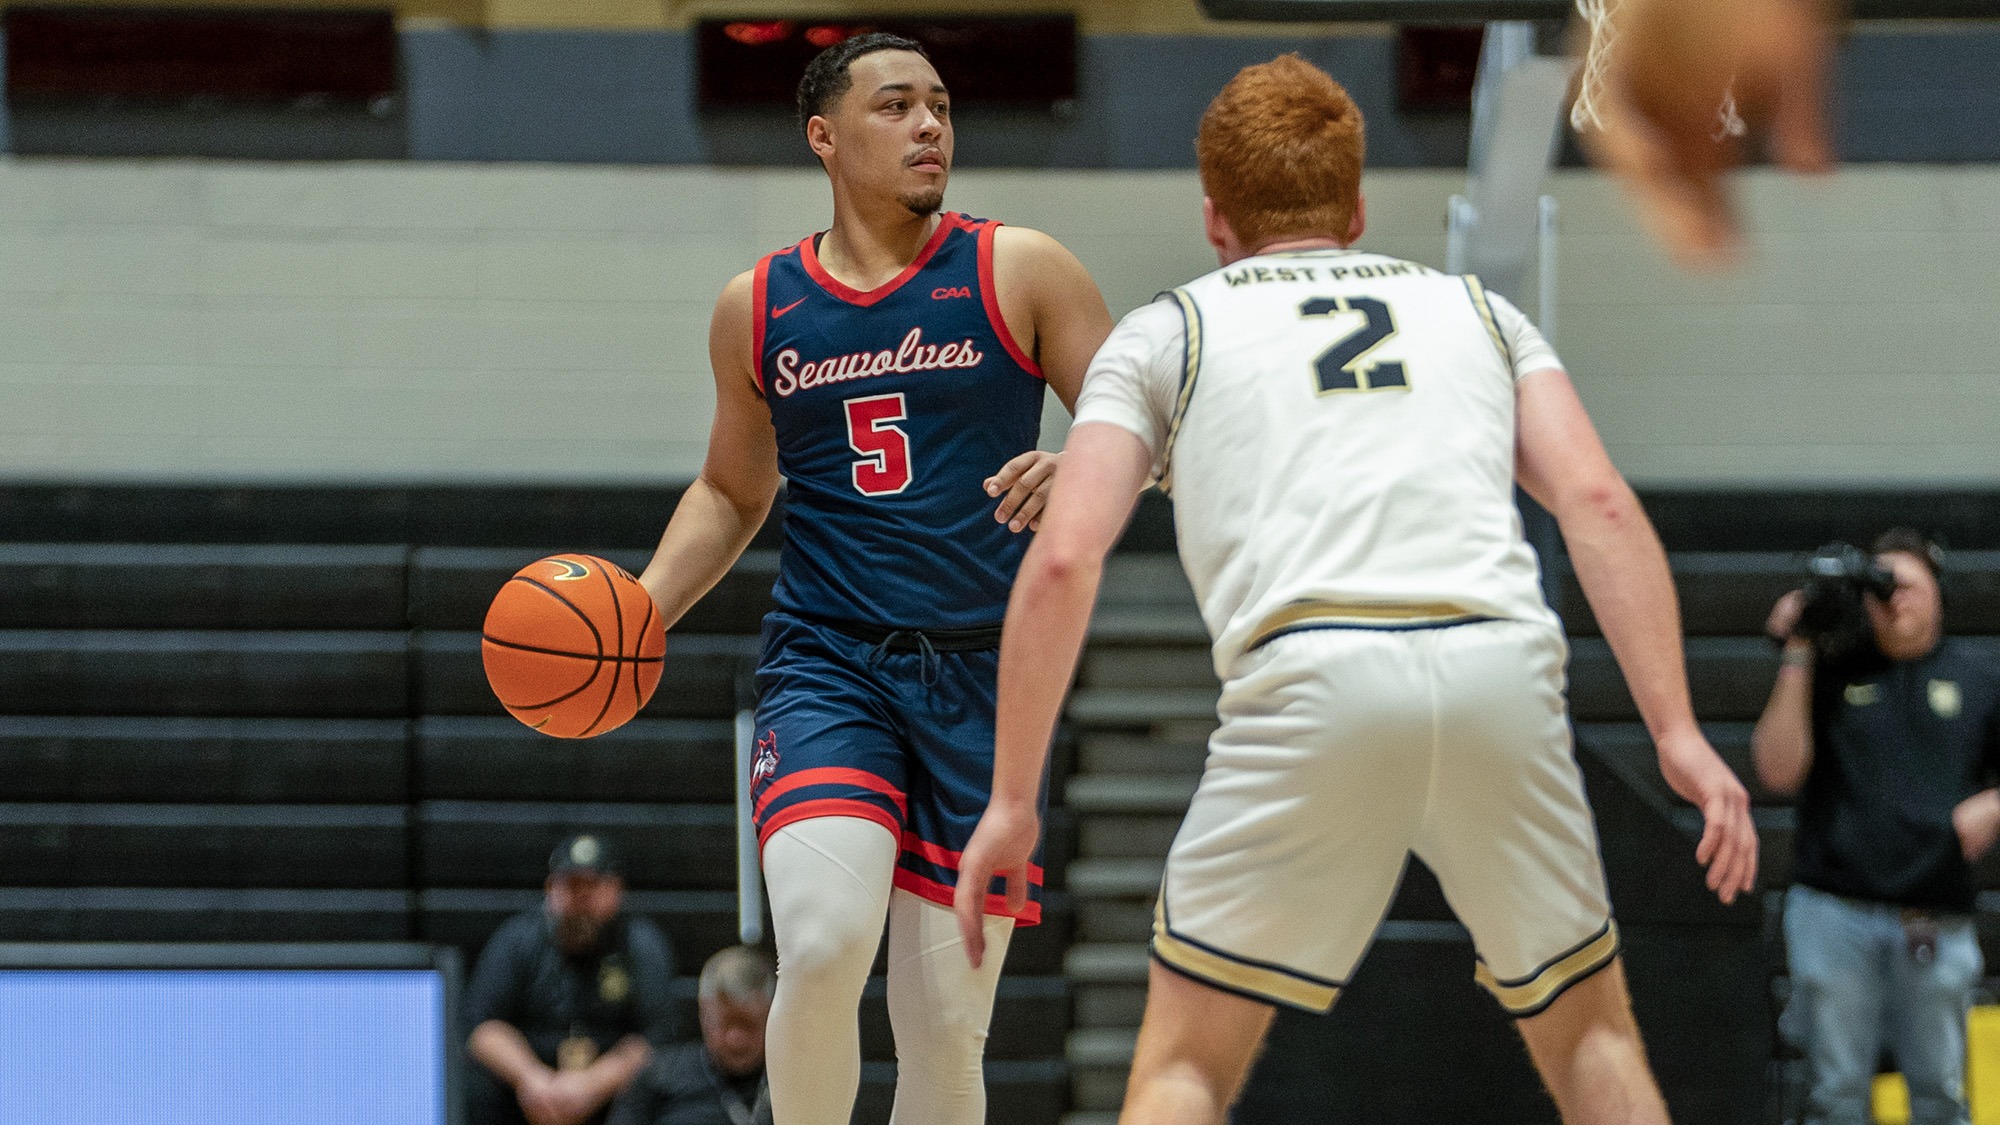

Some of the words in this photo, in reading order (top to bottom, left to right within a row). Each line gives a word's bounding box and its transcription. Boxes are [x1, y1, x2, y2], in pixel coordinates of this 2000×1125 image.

[930, 286, 972, 300] CAA
[1223, 266, 1317, 287] WEST
[1329, 261, 1429, 280] POINT
[774, 326, 983, 397] Seawolves
[1296, 296, 1412, 397] 2
[843, 392, 913, 497] 5
